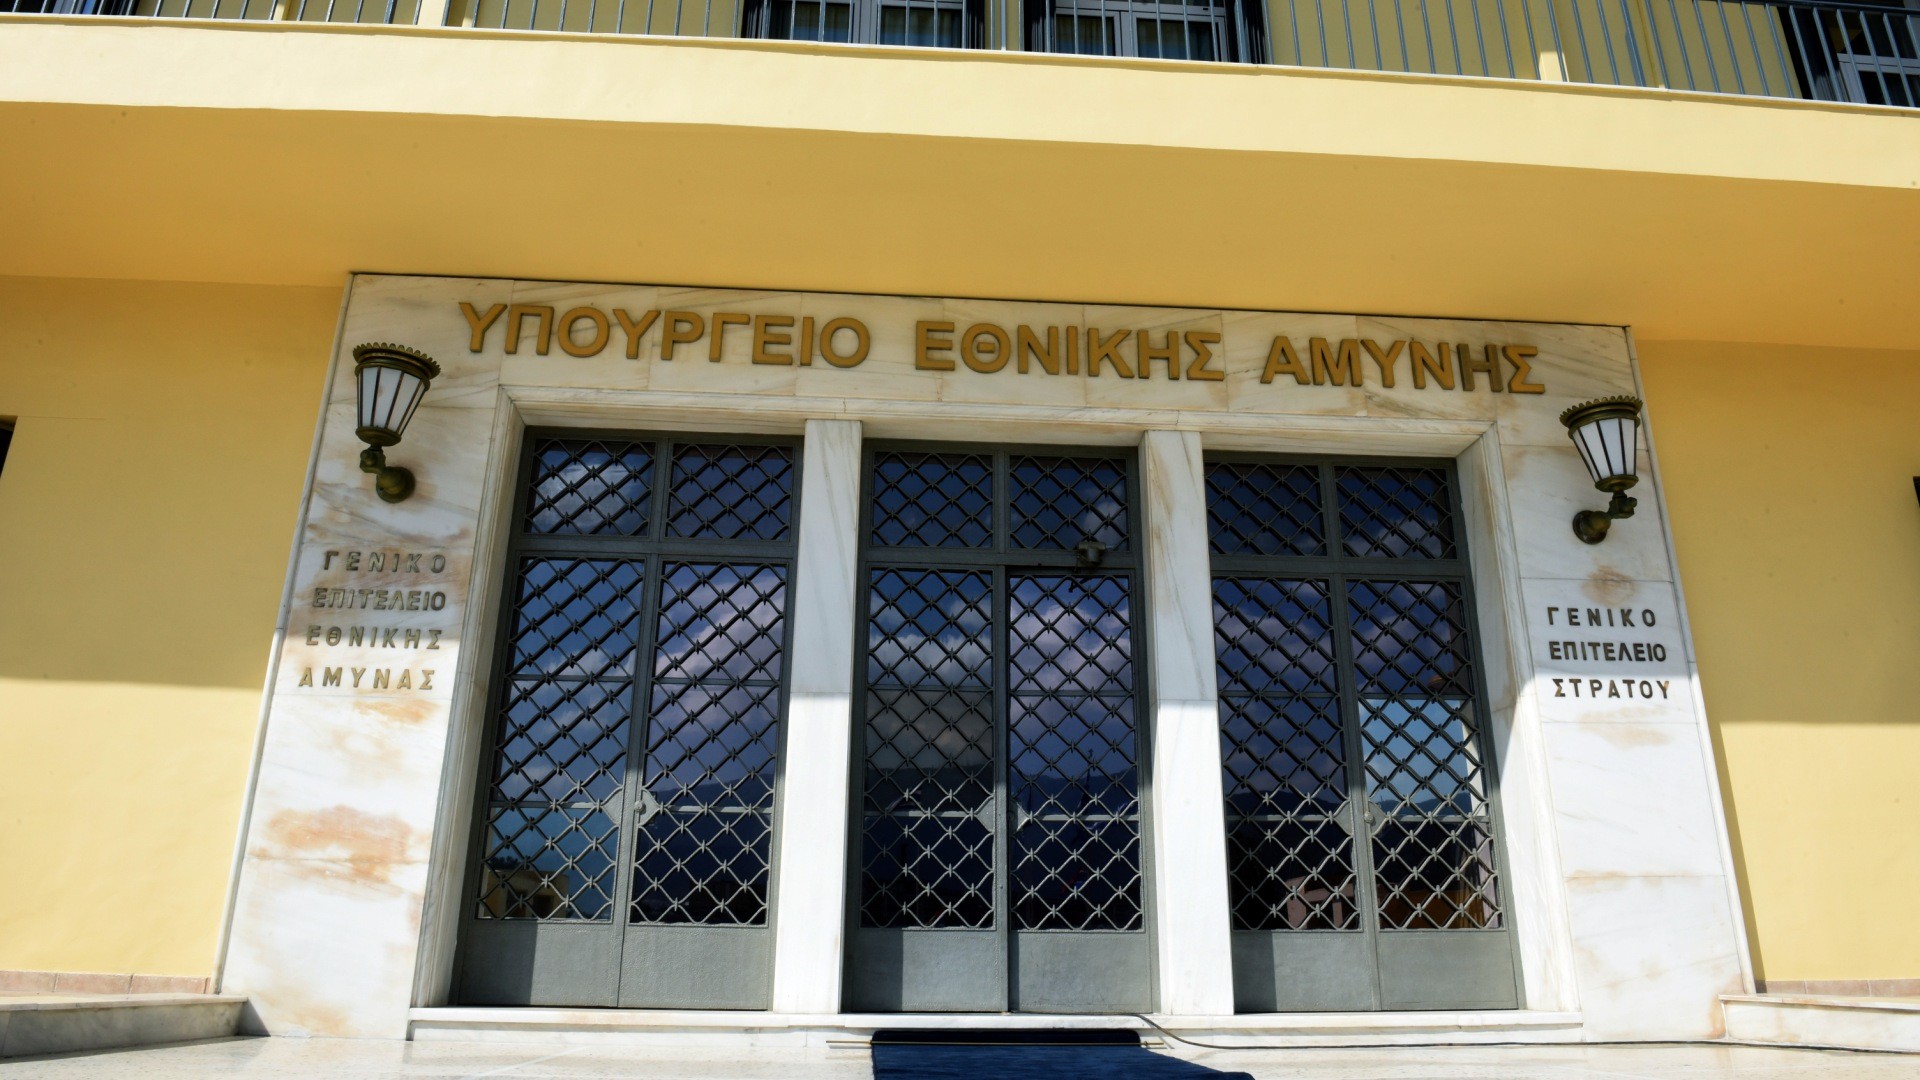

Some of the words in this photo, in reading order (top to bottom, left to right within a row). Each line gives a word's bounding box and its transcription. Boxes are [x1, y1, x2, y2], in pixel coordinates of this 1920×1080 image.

[458, 302, 871, 369] ΥΠΟΥΡΓΕΙΟ
[915, 320, 1225, 381] ΕΘΝΙΚΗΣ
[1260, 335, 1546, 395] ΑΜΥΝΗΣ
[323, 550, 446, 573] ΓΕΝΙΚΟ
[312, 588, 446, 612] ΕΠΙΤΕΛΕΙΟ
[1547, 606, 1656, 627] ΓΕΝΙΚΟ
[306, 625, 442, 650] ΕΘΝΙΚΗΣ
[1549, 641, 1667, 662] ΕΠΙΤΕΛΕΙΟ
[298, 667, 435, 690] ΑΜΥΝΑΣ
[1552, 678, 1670, 699] ΣΤΡΑΤΟΥ
